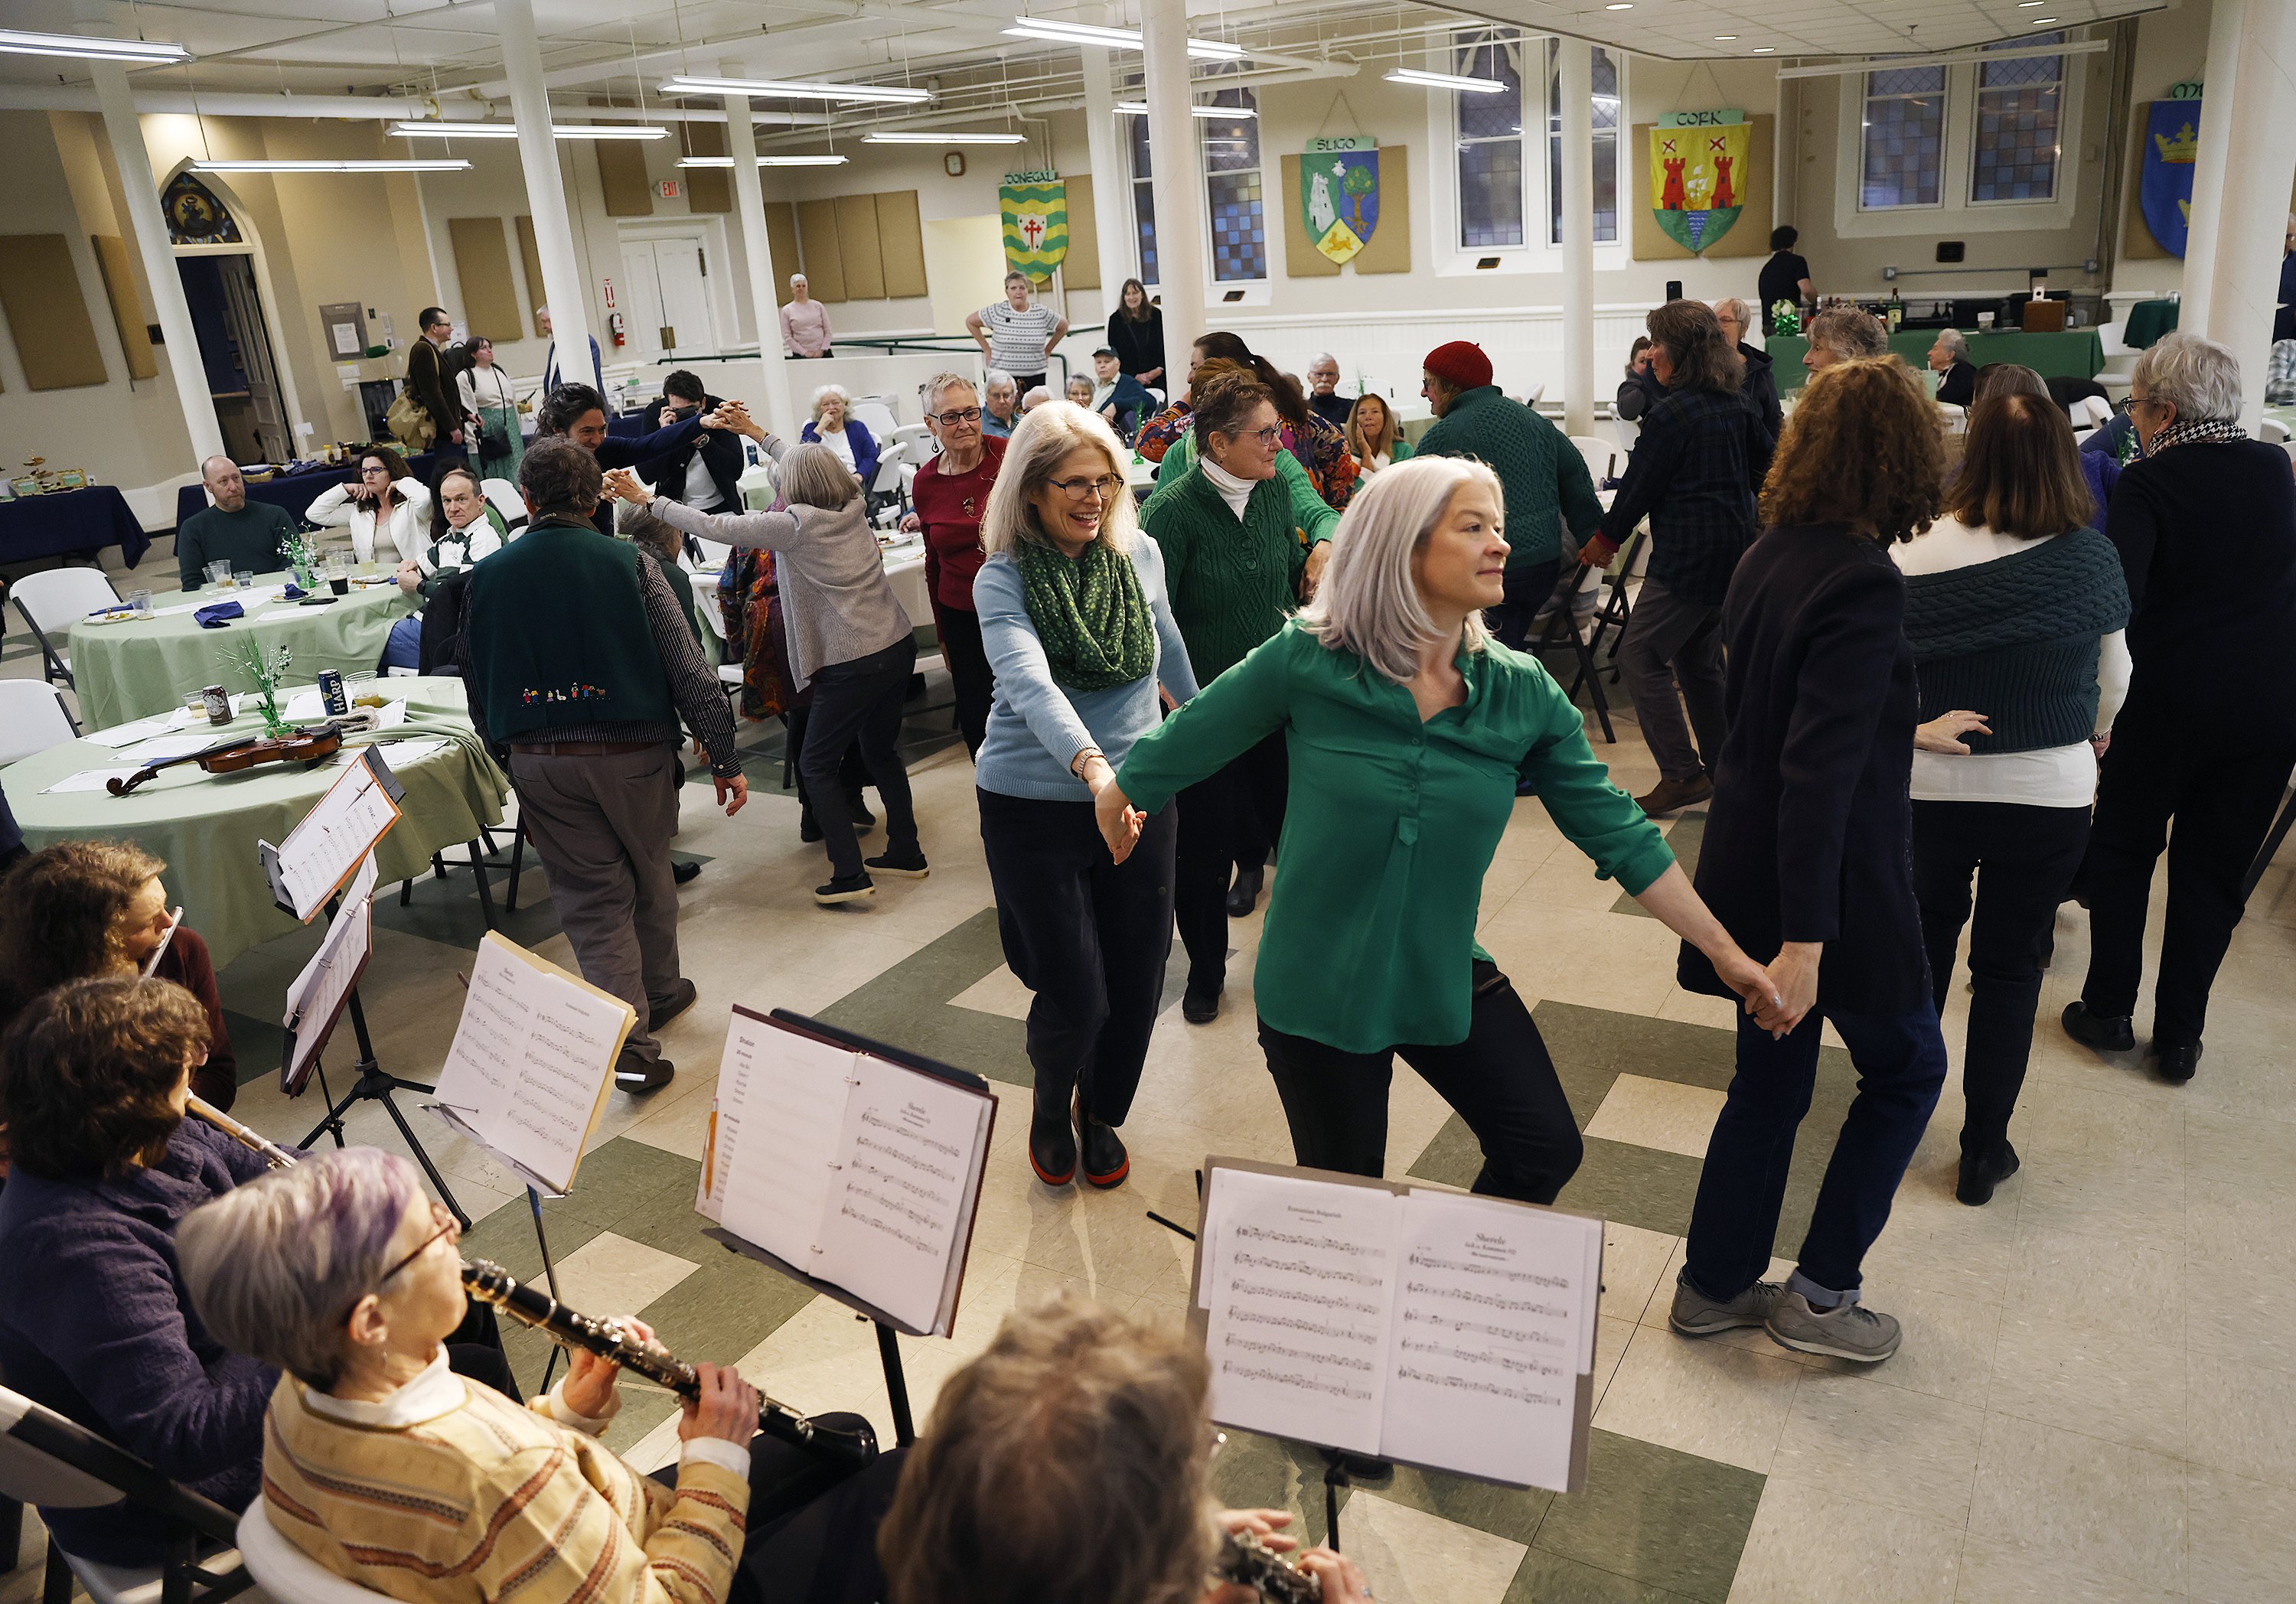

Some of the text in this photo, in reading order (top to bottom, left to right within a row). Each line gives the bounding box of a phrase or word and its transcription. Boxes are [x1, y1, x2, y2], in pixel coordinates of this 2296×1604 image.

[1677, 111, 1722, 126] CORK
[1317, 139, 1355, 150] SLIGO
[1004, 171, 1054, 184] DONEGAL
[662, 181, 677, 196] EXIT
[330, 680, 345, 712] HARP
